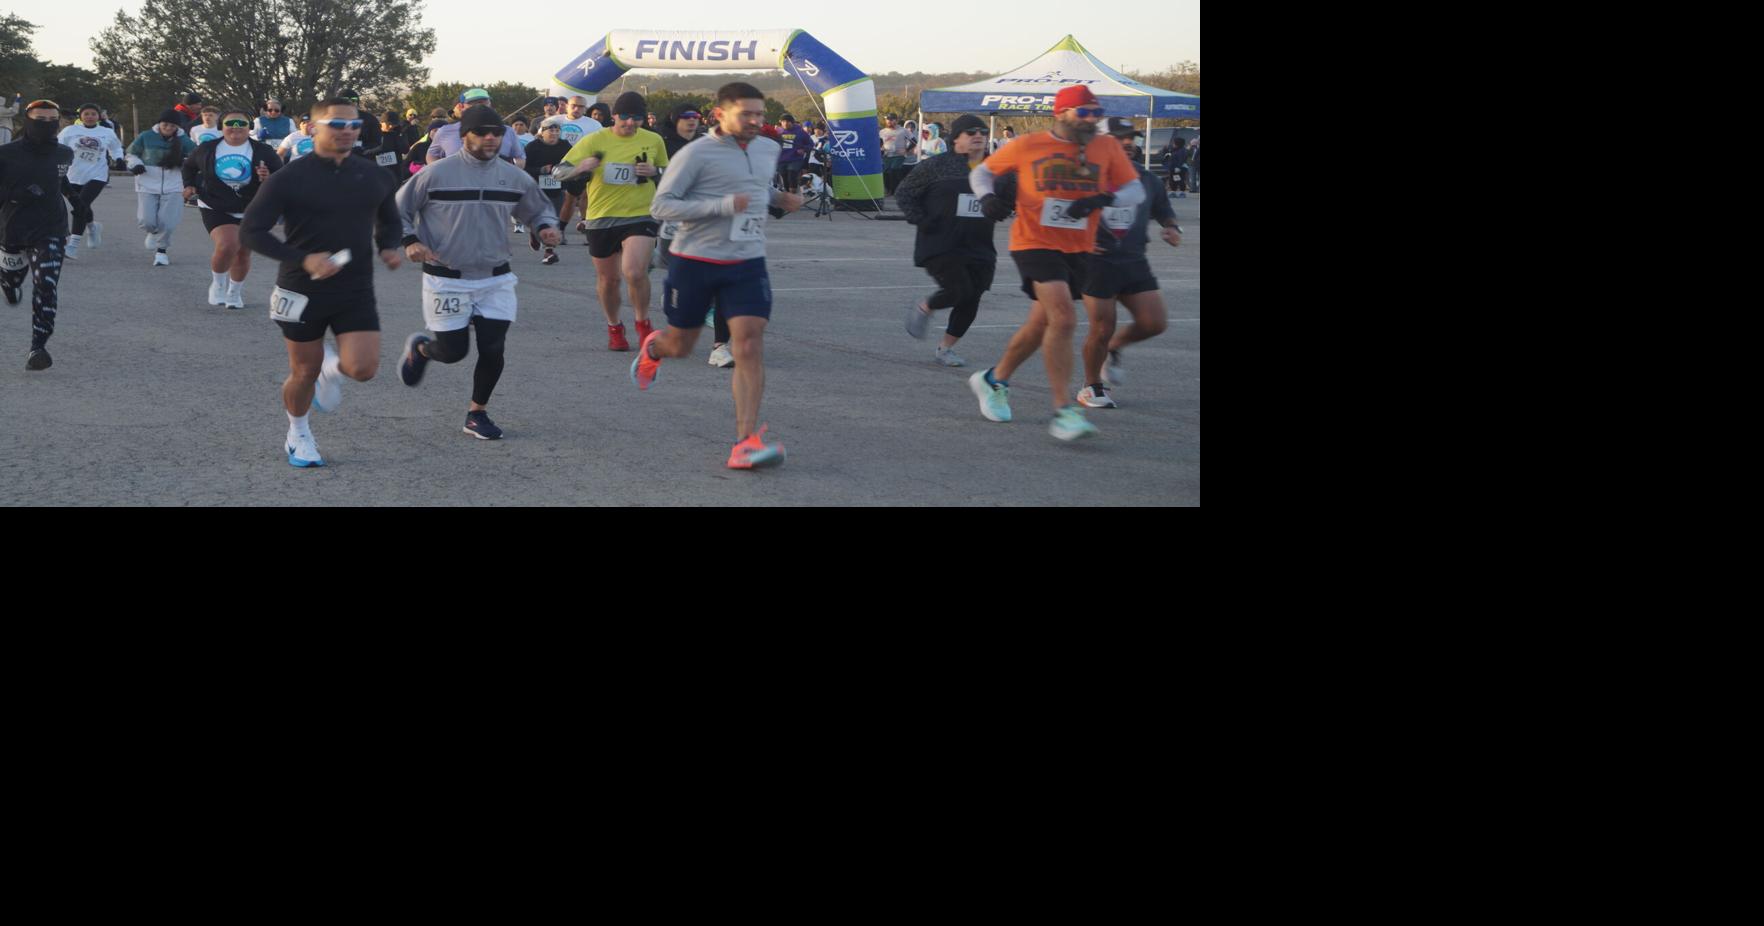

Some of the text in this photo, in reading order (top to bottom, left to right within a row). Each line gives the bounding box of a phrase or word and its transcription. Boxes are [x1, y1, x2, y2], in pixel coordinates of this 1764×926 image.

[635, 39, 758, 61] FINISH
[981, 94, 1056, 106] PRO-F
[998, 103, 1031, 111] RACE
[614, 167, 630, 181] 70
[271, 294, 295, 317] 301
[433, 297, 460, 315] 243
